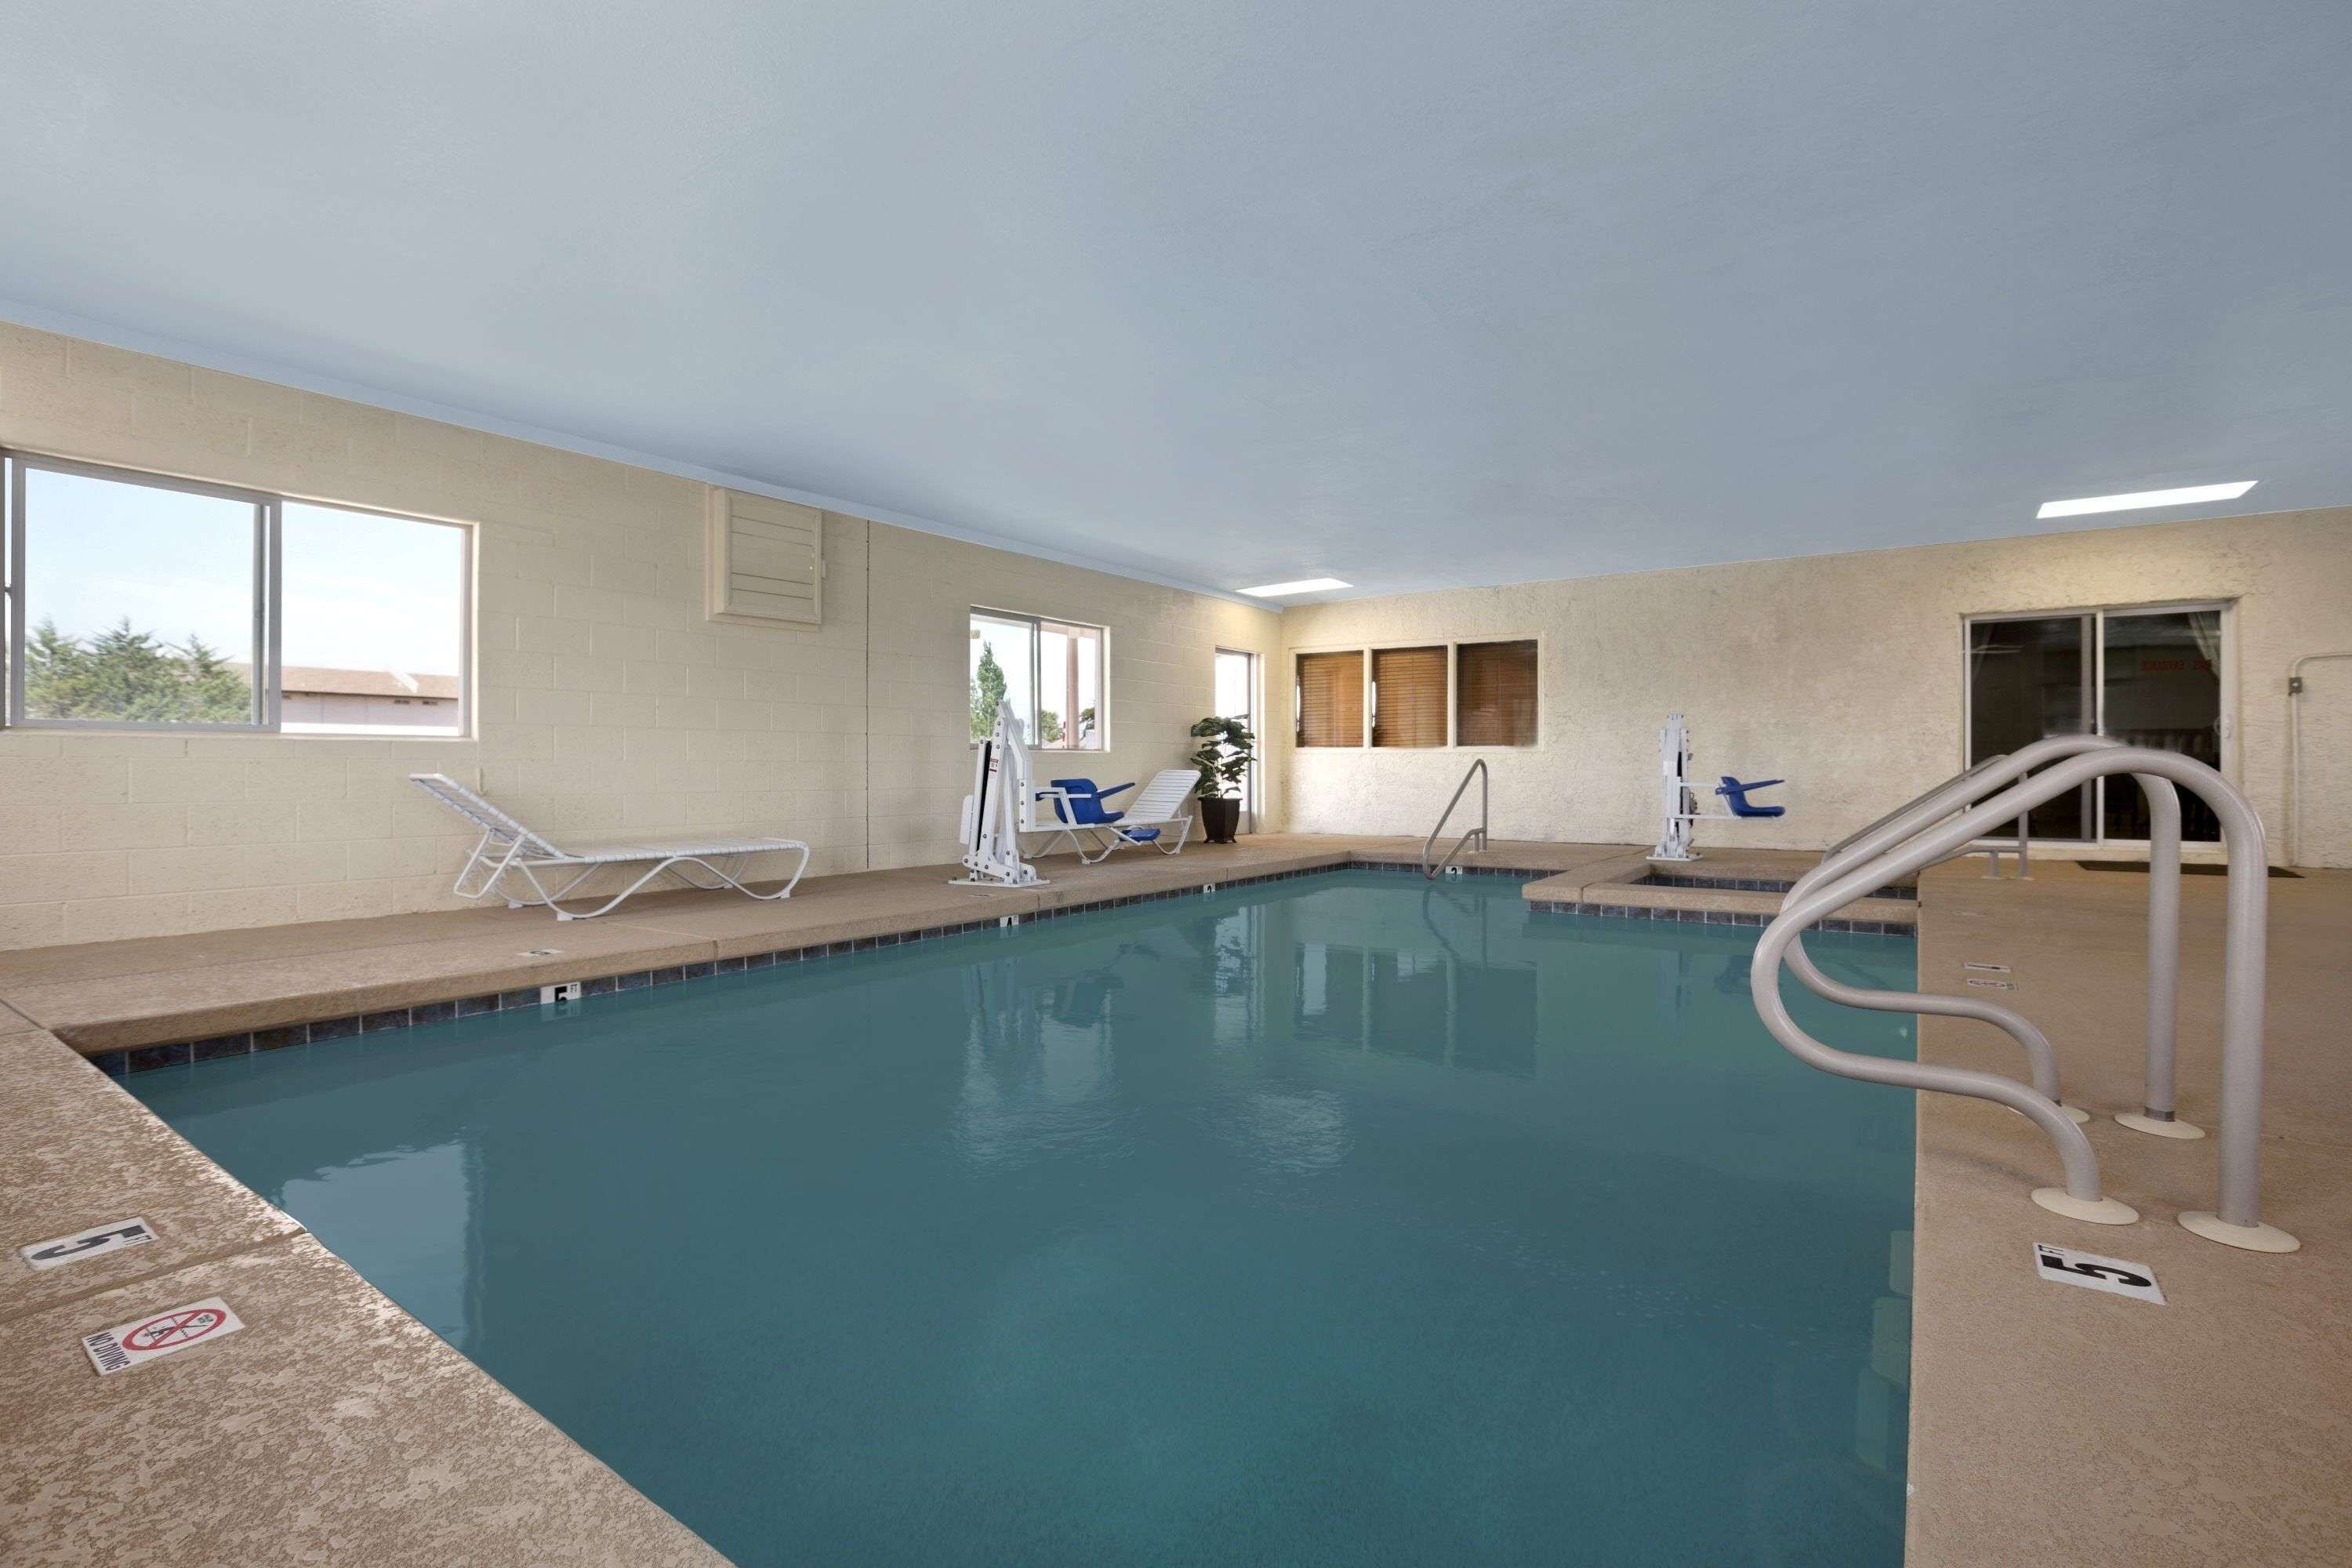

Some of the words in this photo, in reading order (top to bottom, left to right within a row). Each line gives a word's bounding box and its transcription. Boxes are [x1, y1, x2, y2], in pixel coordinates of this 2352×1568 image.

[31, 1225, 146, 1260] 5
[2038, 1244, 2064, 1256] FT
[2040, 1254, 2152, 1287] 5
[85, 1332, 114, 1346] NO
[93, 1342, 131, 1371] DIVING
